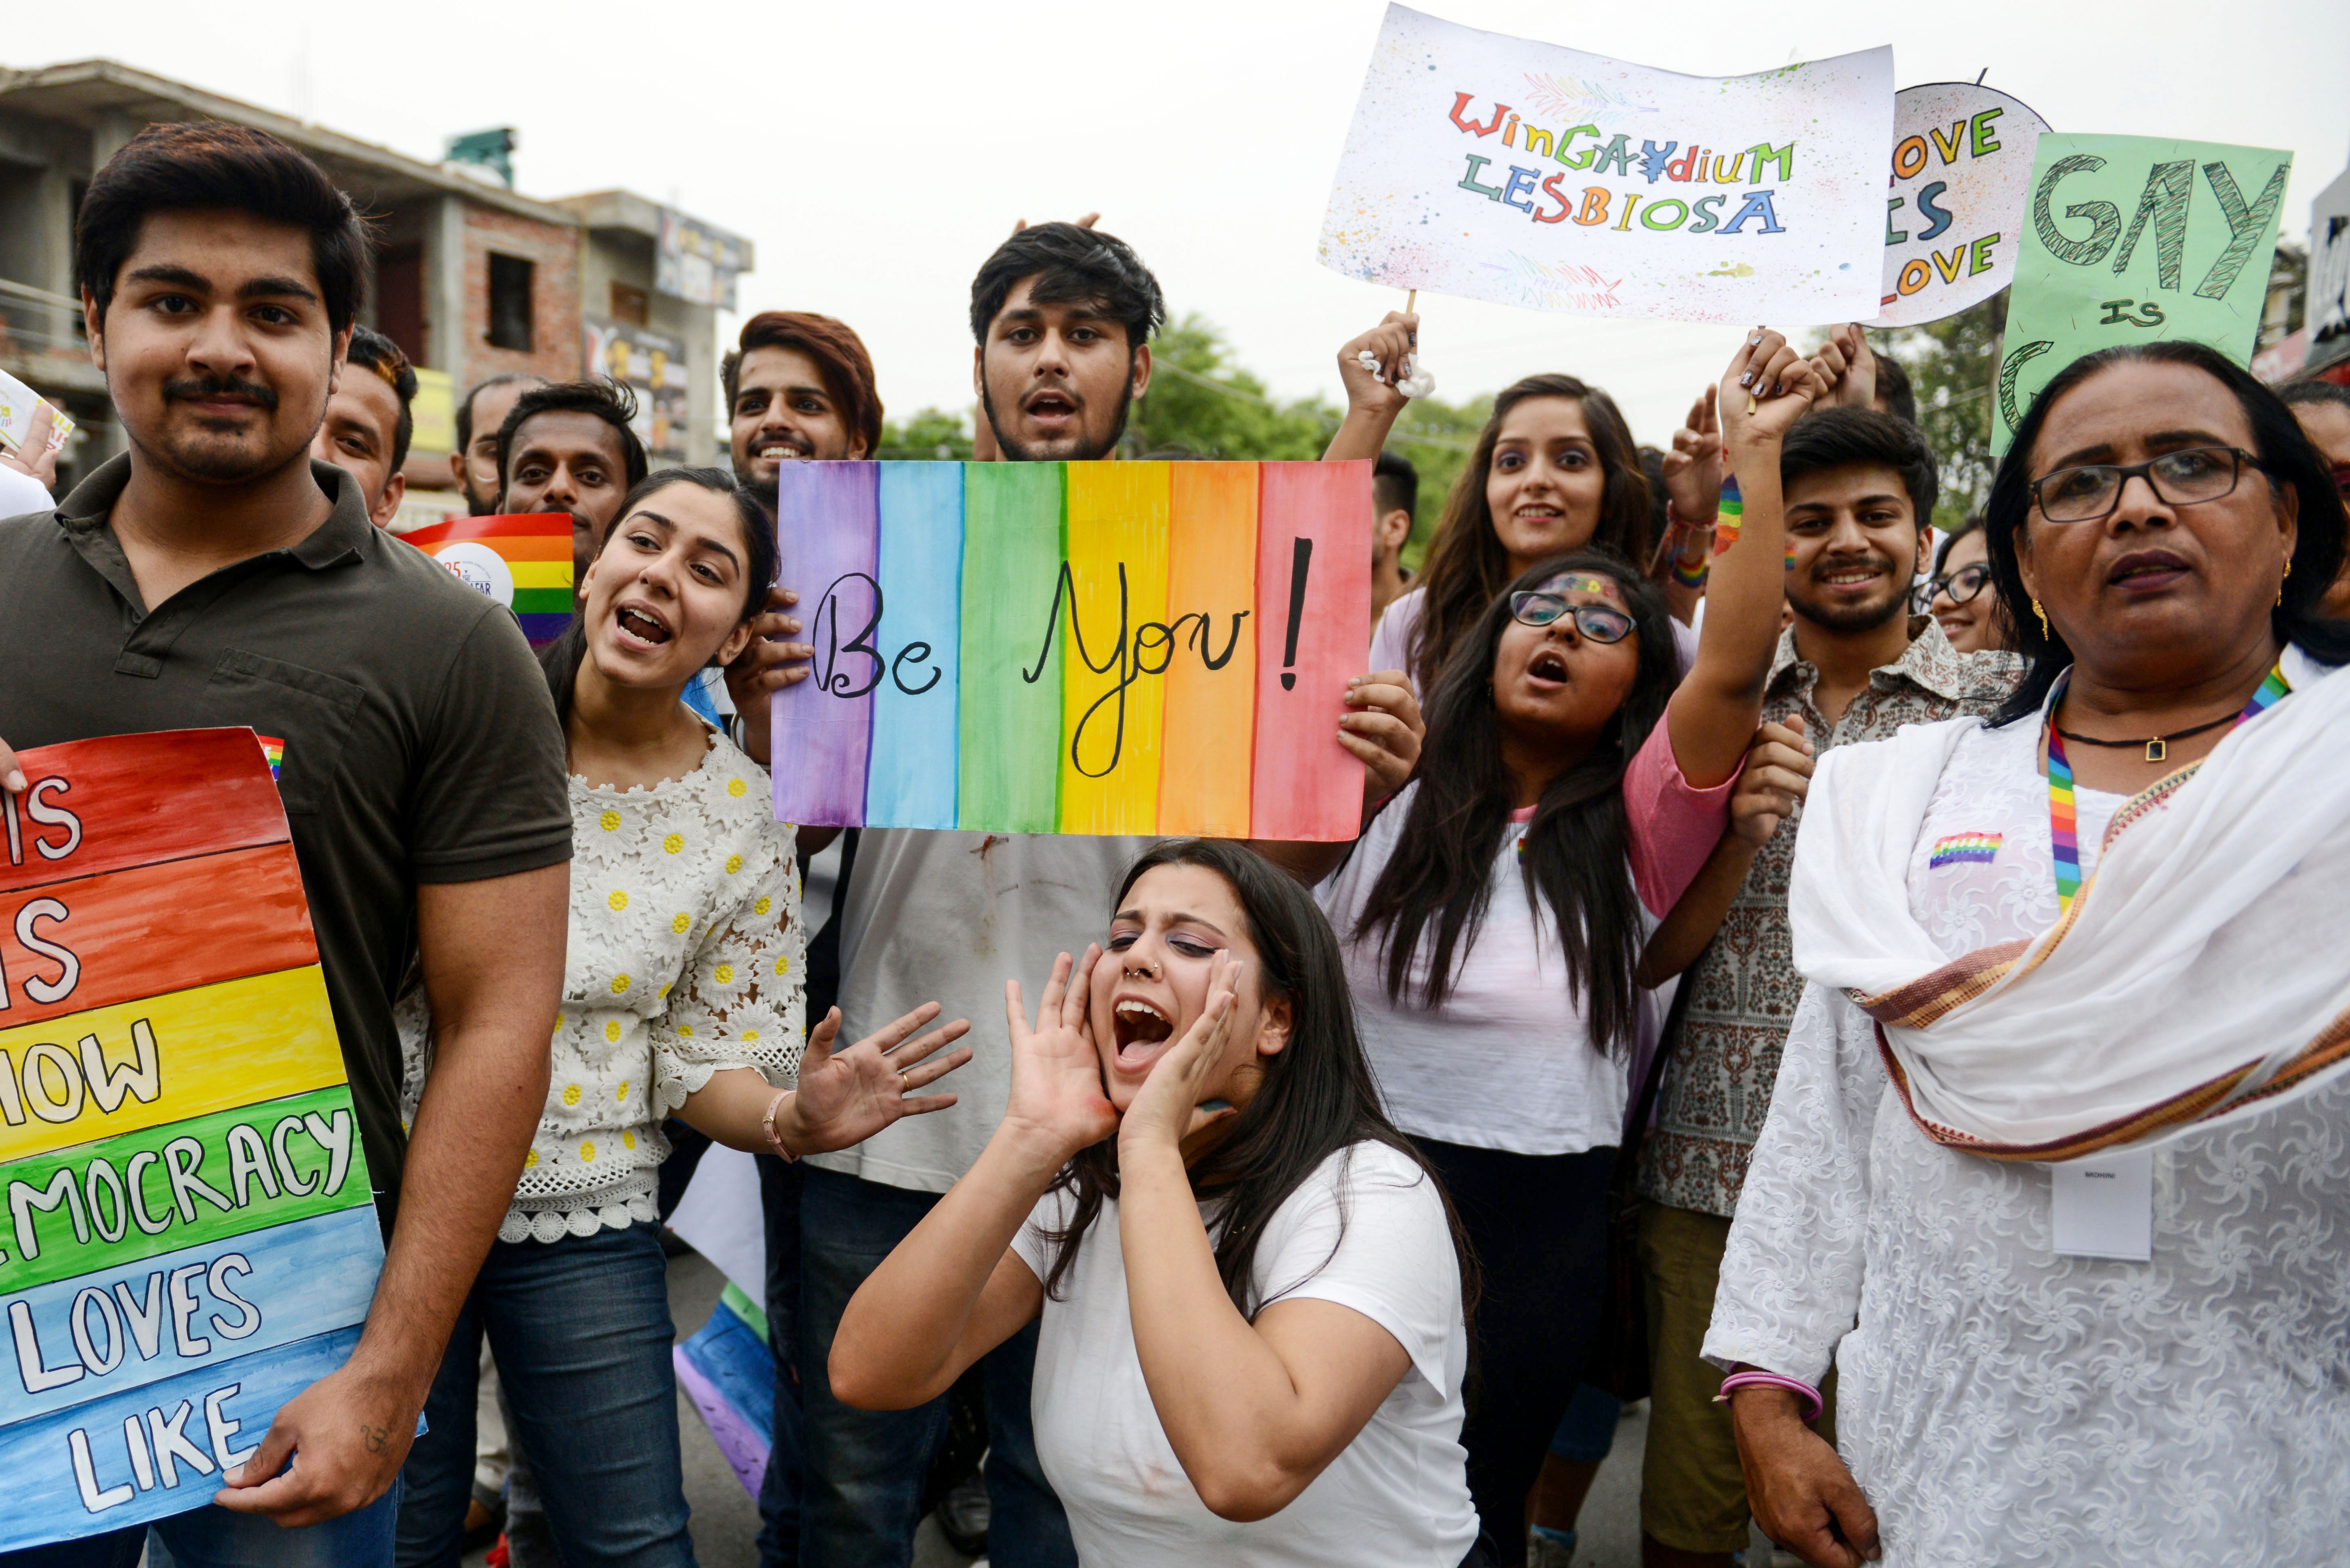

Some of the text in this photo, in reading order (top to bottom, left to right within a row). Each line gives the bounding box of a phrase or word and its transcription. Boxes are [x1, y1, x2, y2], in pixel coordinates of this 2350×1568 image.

[1889, 107, 2004, 187] OVE
[1457, 154, 1785, 235] LESBIOSA
[2034, 154, 2290, 300] GAY
[1534, 276, 1572, 291] PRIDE
[2100, 298, 2166, 327] IS
[471, 583, 491, 595] FAR
[812, 572, 941, 698] Be
[1940, 838, 1990, 852] PRIDE
[0, 1108, 353, 1265] MOCRACY
[8, 1253, 262, 1394] LOVES
[67, 1383, 260, 1513] LIKE
